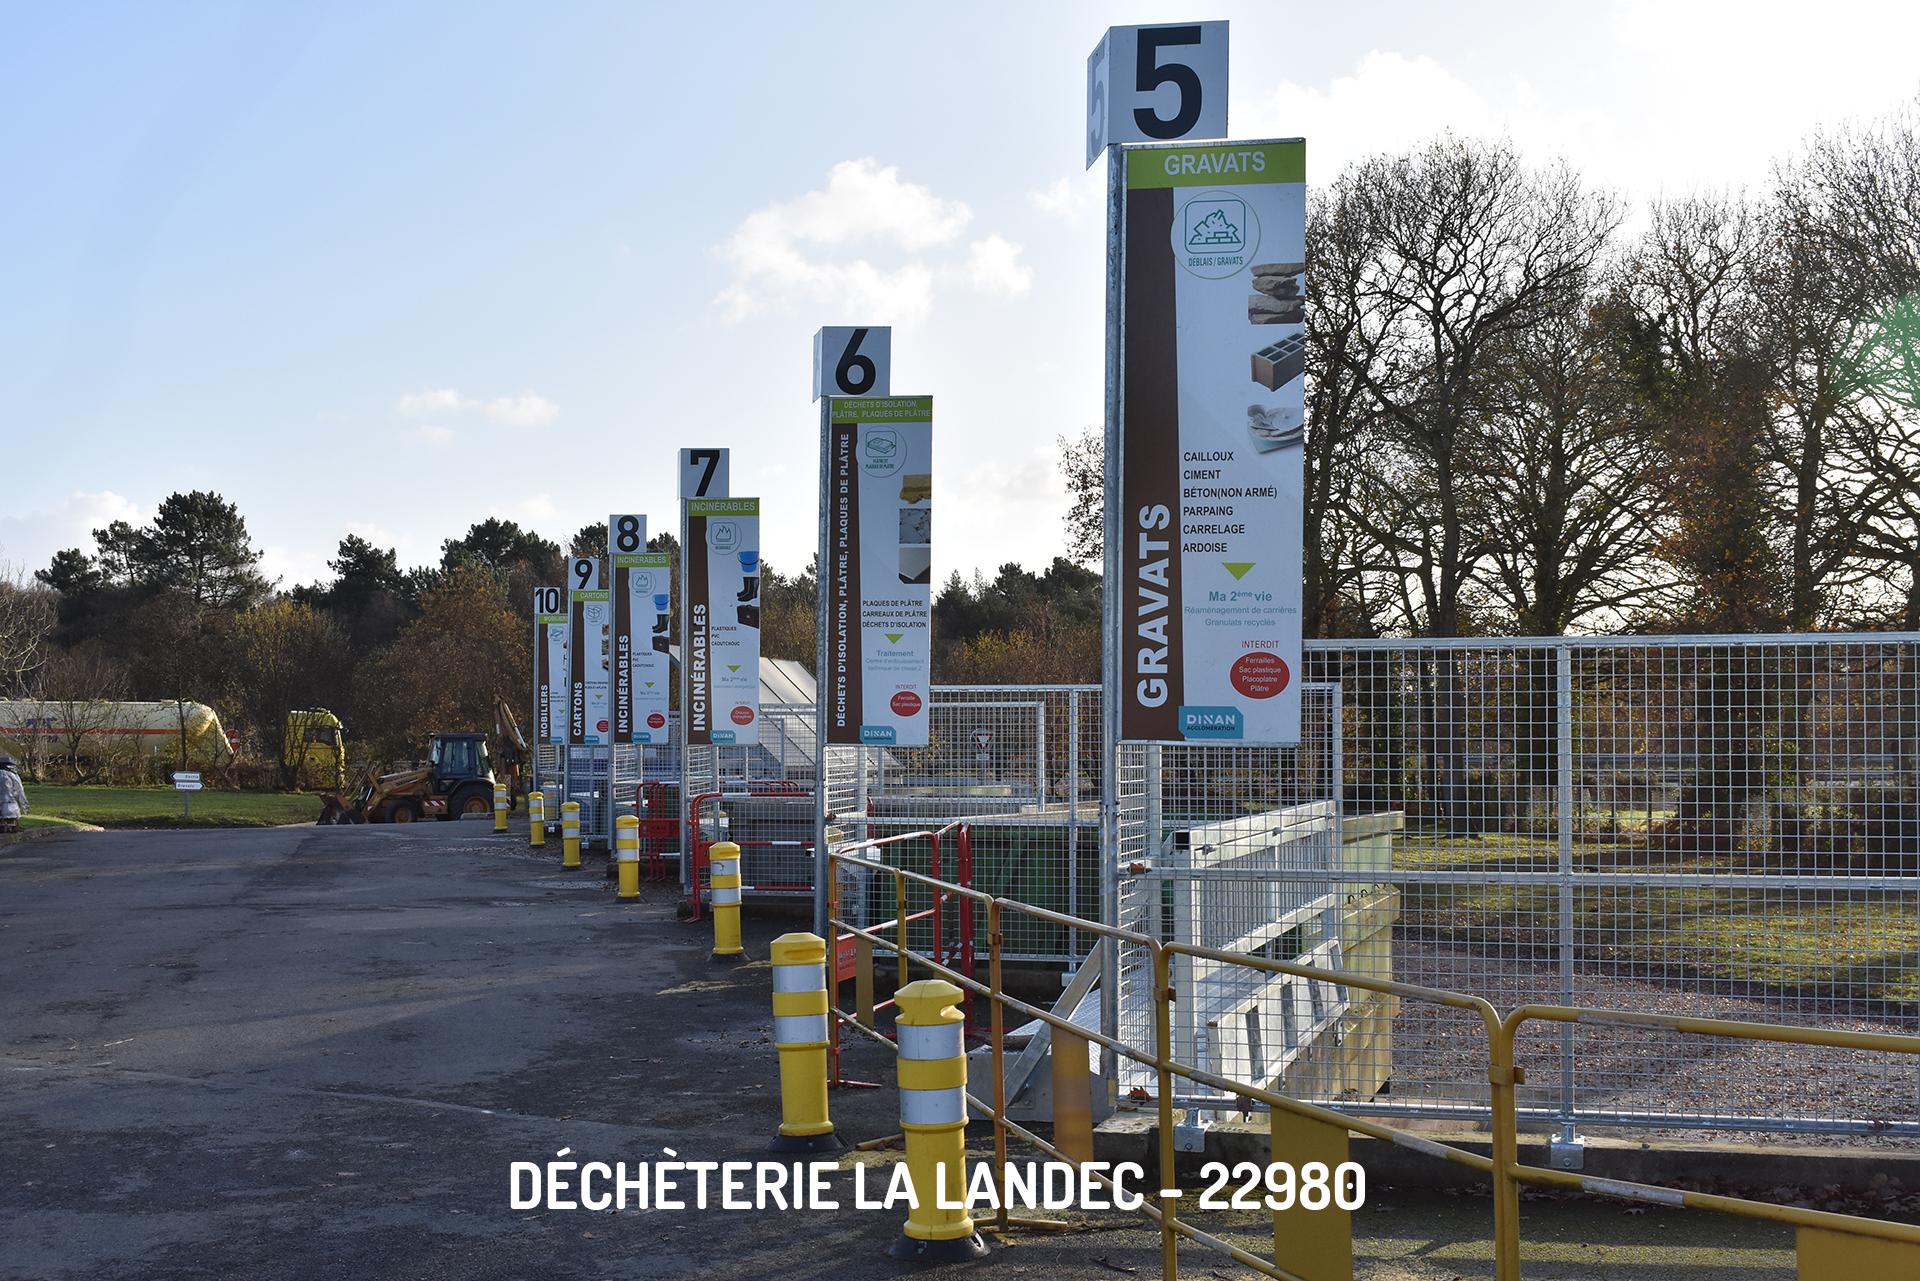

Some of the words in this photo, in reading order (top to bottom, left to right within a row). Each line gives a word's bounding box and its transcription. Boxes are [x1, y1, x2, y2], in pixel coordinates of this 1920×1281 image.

[1133, 25, 1202, 139] 5
[1164, 151, 1265, 175] GRAVATS
[835, 328, 876, 395] 6
[839, 433, 849, 476] PLÂTRE
[1184, 451, 1234, 462] CAILLOUX
[690, 450, 720, 497] 7
[840, 479, 849, 494] DE
[1184, 470, 1221, 480] CIMENT
[1244, 487, 1278, 498] ARMÉ)
[839, 497, 849, 547] PLAQUES
[1183, 506, 1233, 517] PARPAING
[617, 515, 639, 552] 8
[1183, 524, 1245, 535] CARRELAGE
[1183, 543, 1228, 553] ARDOISE
[574, 559, 593, 589] 9
[536, 588, 559, 613] 10
[1137, 504, 1170, 708] GRAVATS
[1209, 591, 1226, 602] Ma
[1254, 591, 1272, 602] vie
[1252, 606, 1261, 614] de
[1241, 640, 1280, 649] INTERDIT
[691, 604, 706, 731] INCINÉRABLES
[618, 635, 629, 733] INCINÉRABLES
[573, 682, 583, 736] CARTONS
[836, 675, 846, 727] DÉCHETS
